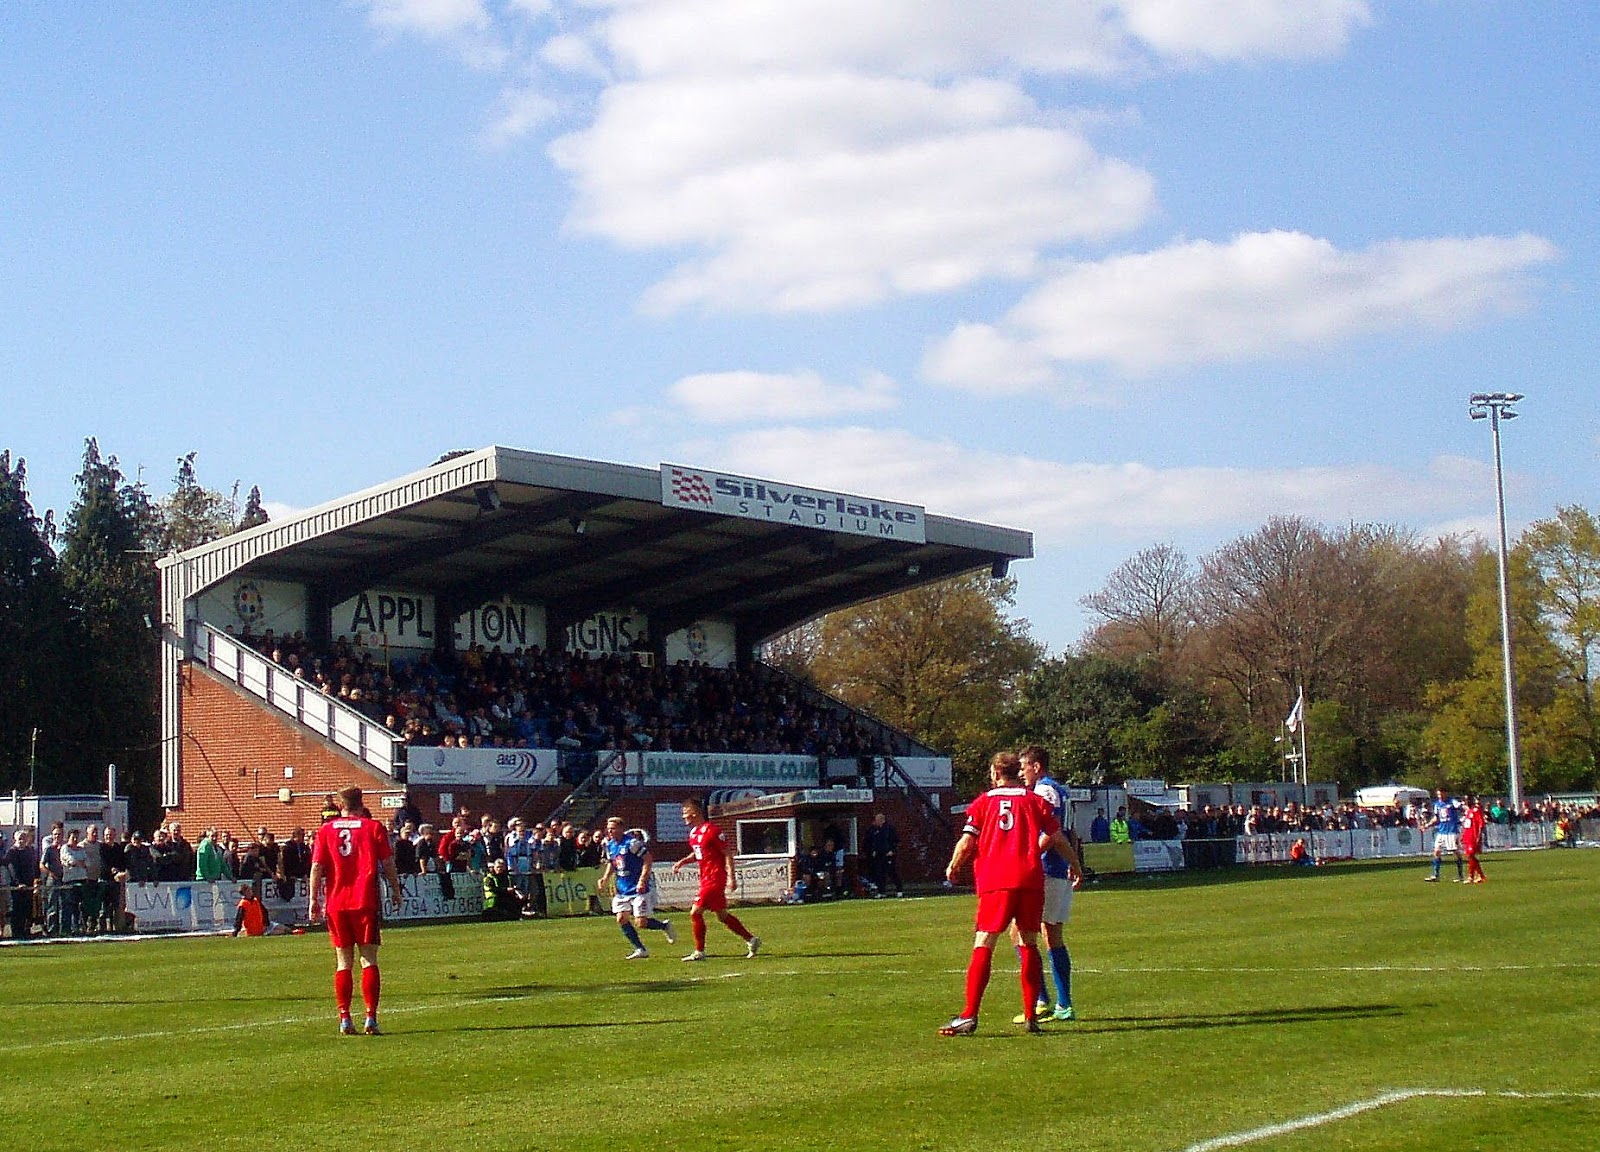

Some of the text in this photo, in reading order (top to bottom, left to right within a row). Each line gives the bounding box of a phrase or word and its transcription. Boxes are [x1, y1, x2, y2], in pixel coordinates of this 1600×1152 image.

[714, 477, 917, 525] Silverlake
[738, 500, 895, 535] STADIUM
[999, 799, 1014, 831] 5
[338, 829, 352, 857] 3
[134, 892, 170, 911] LW
[545, 877, 588, 903] idle
